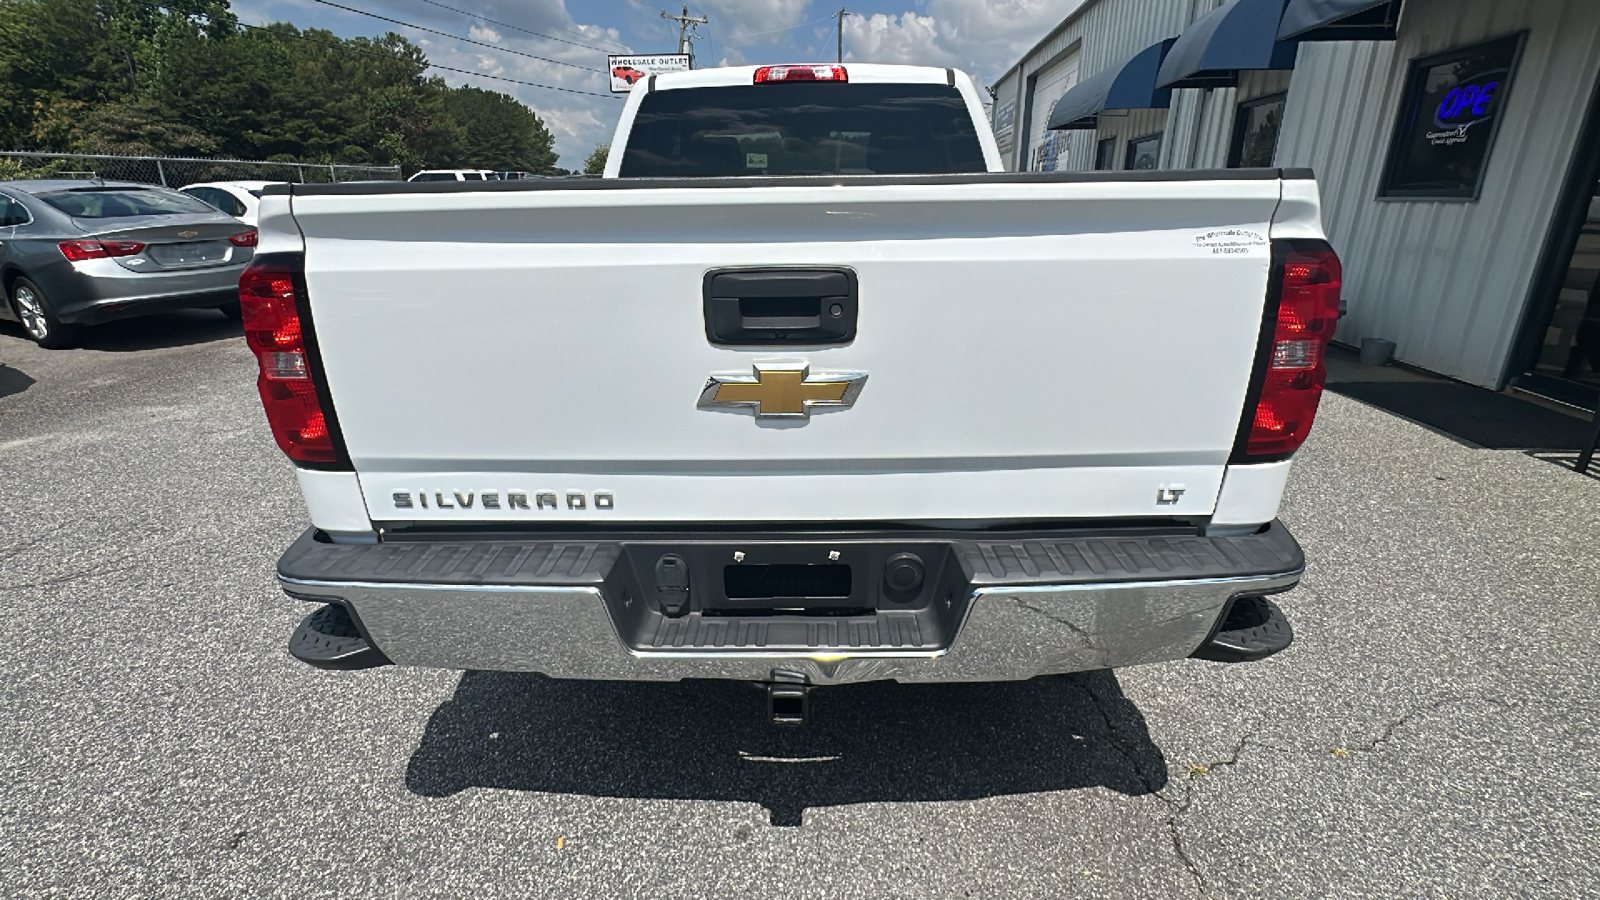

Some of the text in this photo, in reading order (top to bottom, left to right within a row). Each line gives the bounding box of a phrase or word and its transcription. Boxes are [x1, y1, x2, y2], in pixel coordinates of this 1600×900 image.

[611, 57, 688, 66] WHOLESALE OUTLET
[1206, 230, 1236, 239] Wholesale
[392, 491, 615, 510] SILVERADO
[1156, 488, 1186, 505] LT
